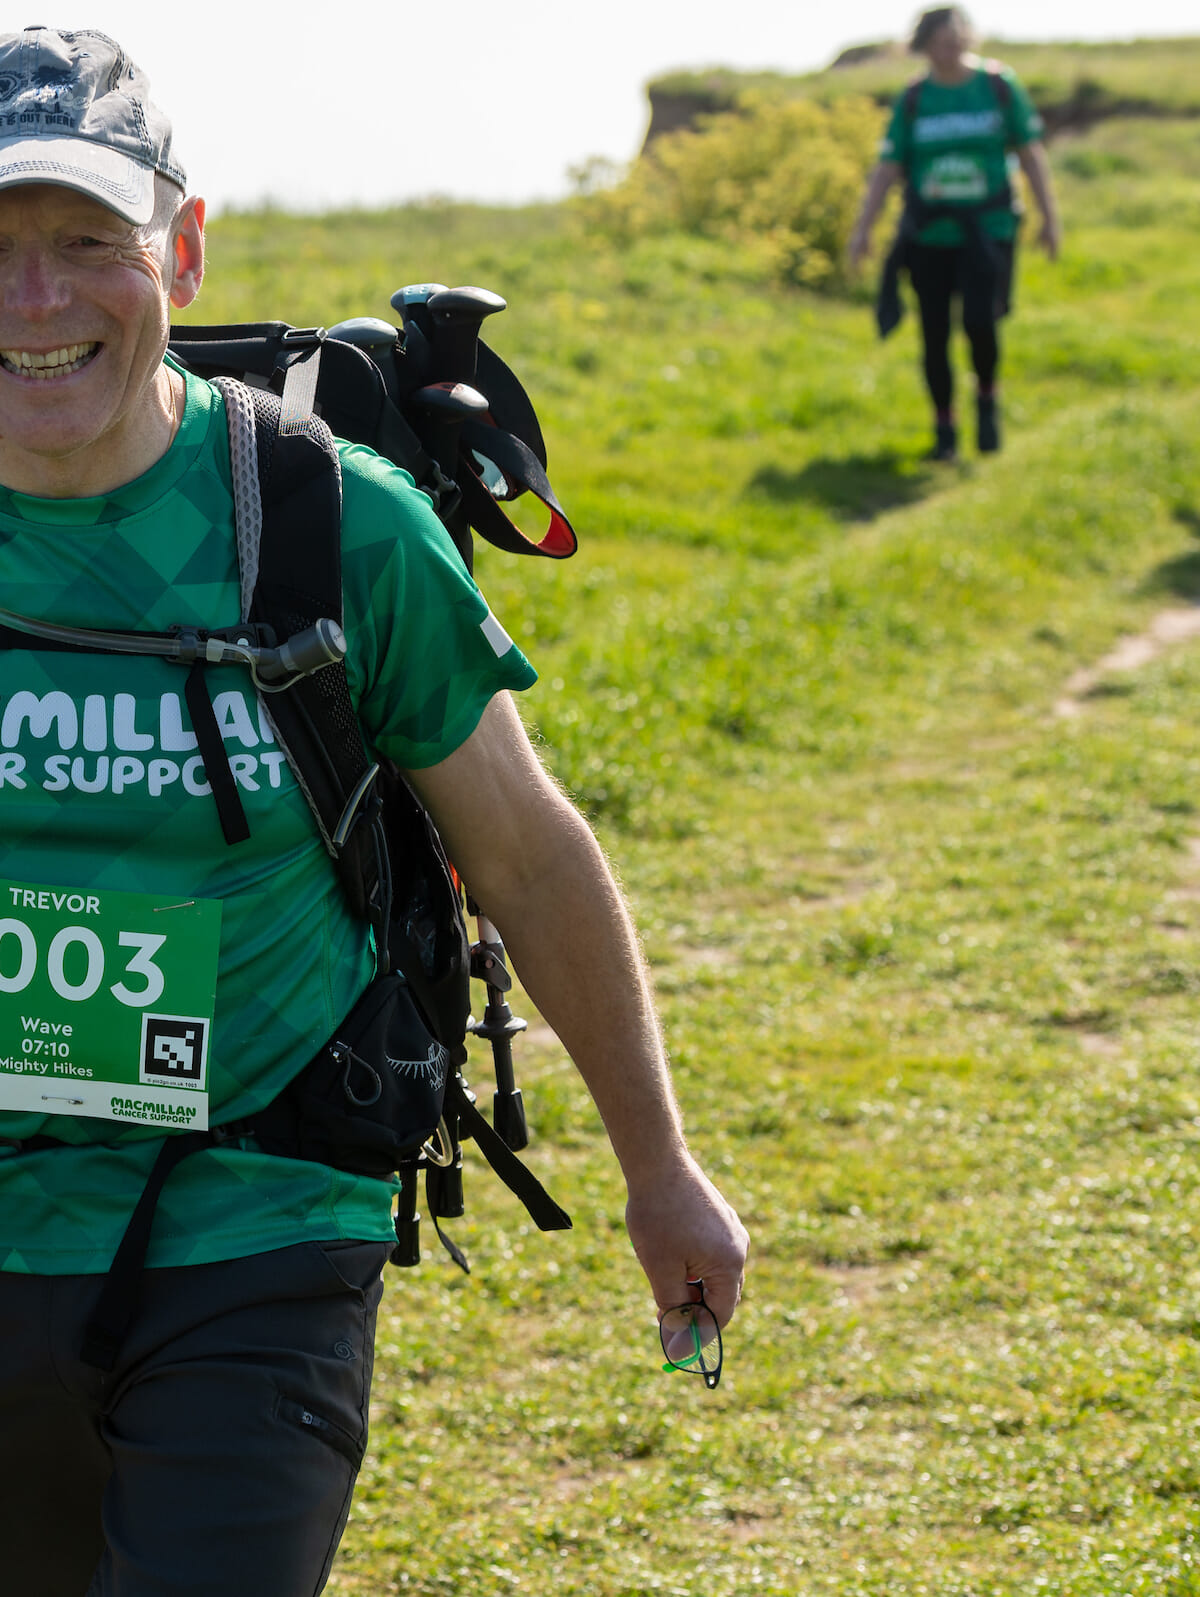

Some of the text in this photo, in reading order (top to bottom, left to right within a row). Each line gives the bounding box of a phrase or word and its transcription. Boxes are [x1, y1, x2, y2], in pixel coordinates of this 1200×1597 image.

[19, 113, 41, 124] OUT
[44, 114, 76, 128] THERE
[43, 751, 287, 797] SUPPORT
[8, 887, 101, 914] TREVOR
[20, 1015, 73, 1037] Wave
[21, 1039, 70, 1059] 07:10
[53, 1061, 94, 1078] Hikes
[110, 1096, 197, 1117] MACMILLAN
[112, 1107, 192, 1125] CANCER SUPPORT
